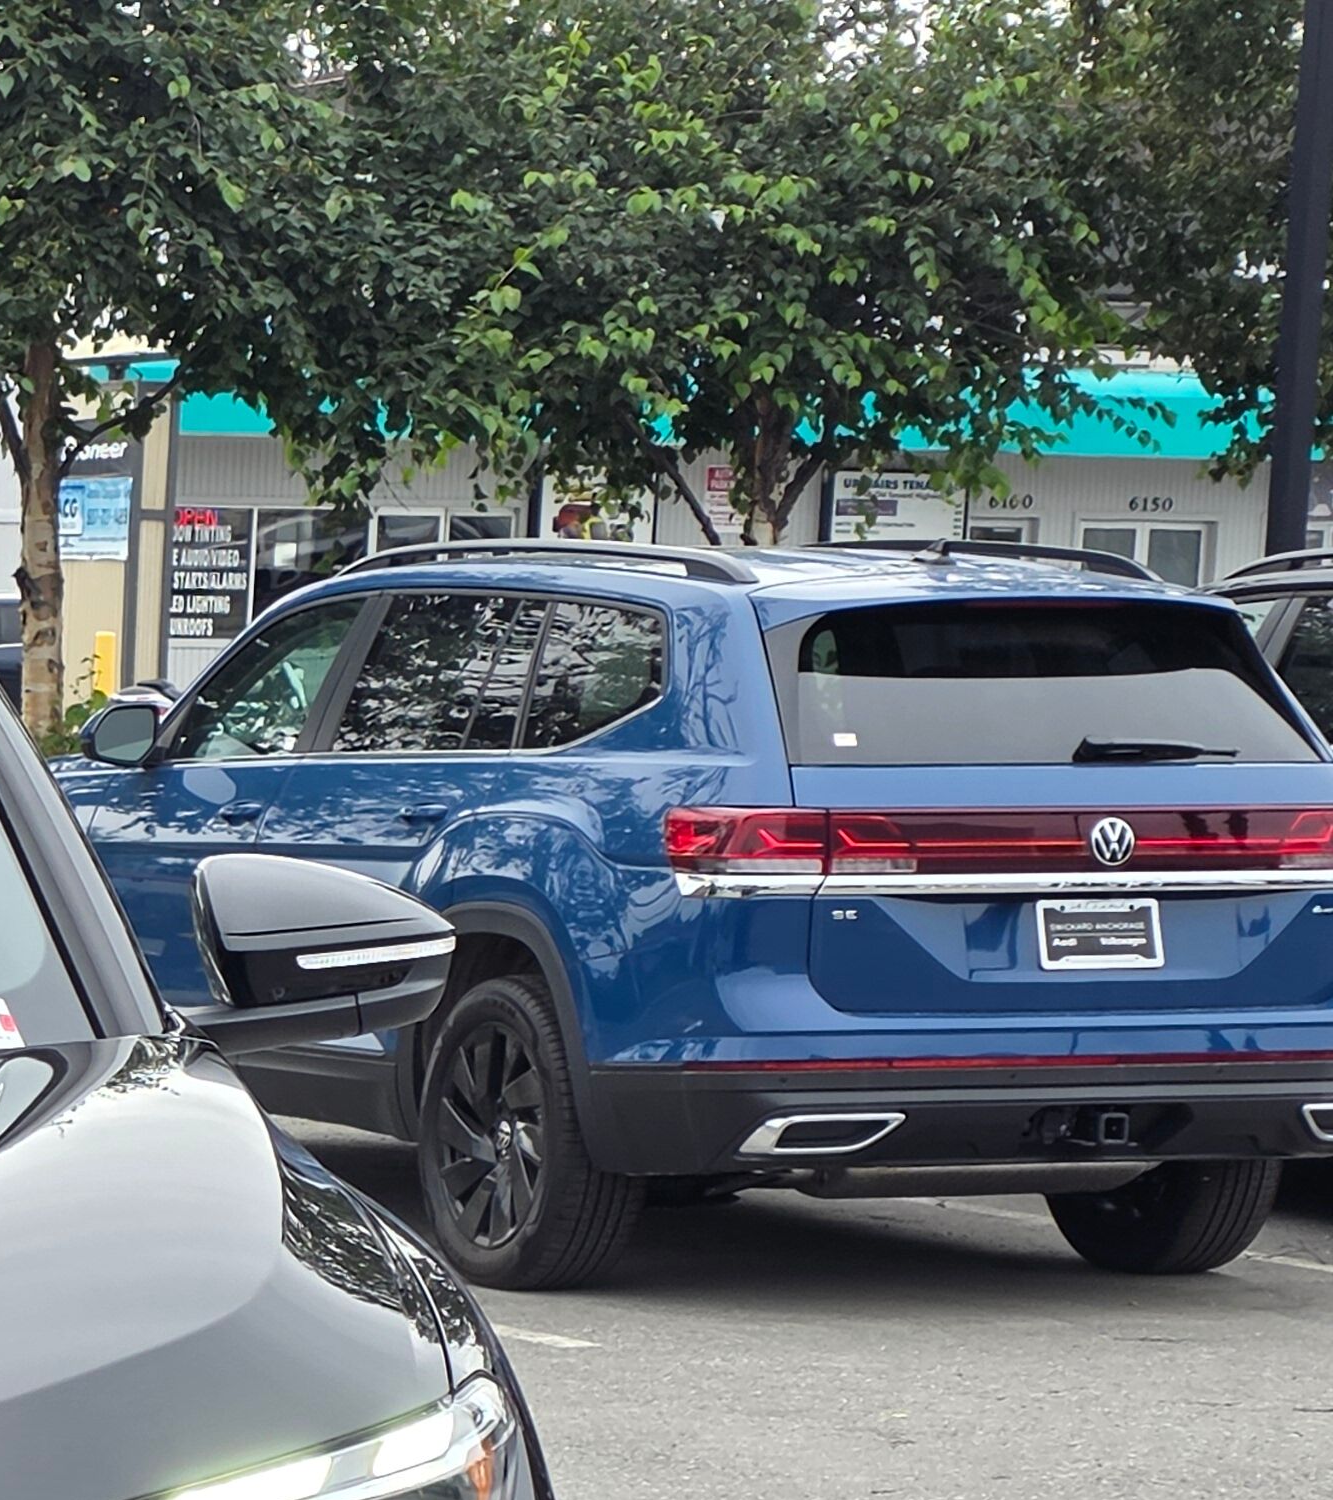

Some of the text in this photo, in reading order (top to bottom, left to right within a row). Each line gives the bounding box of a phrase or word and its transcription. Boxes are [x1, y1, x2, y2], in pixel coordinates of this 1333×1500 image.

[1129, 496, 1173, 512] 6150
[194, 525, 232, 542] TINTING
[186, 594, 231, 614] LIGHTING
